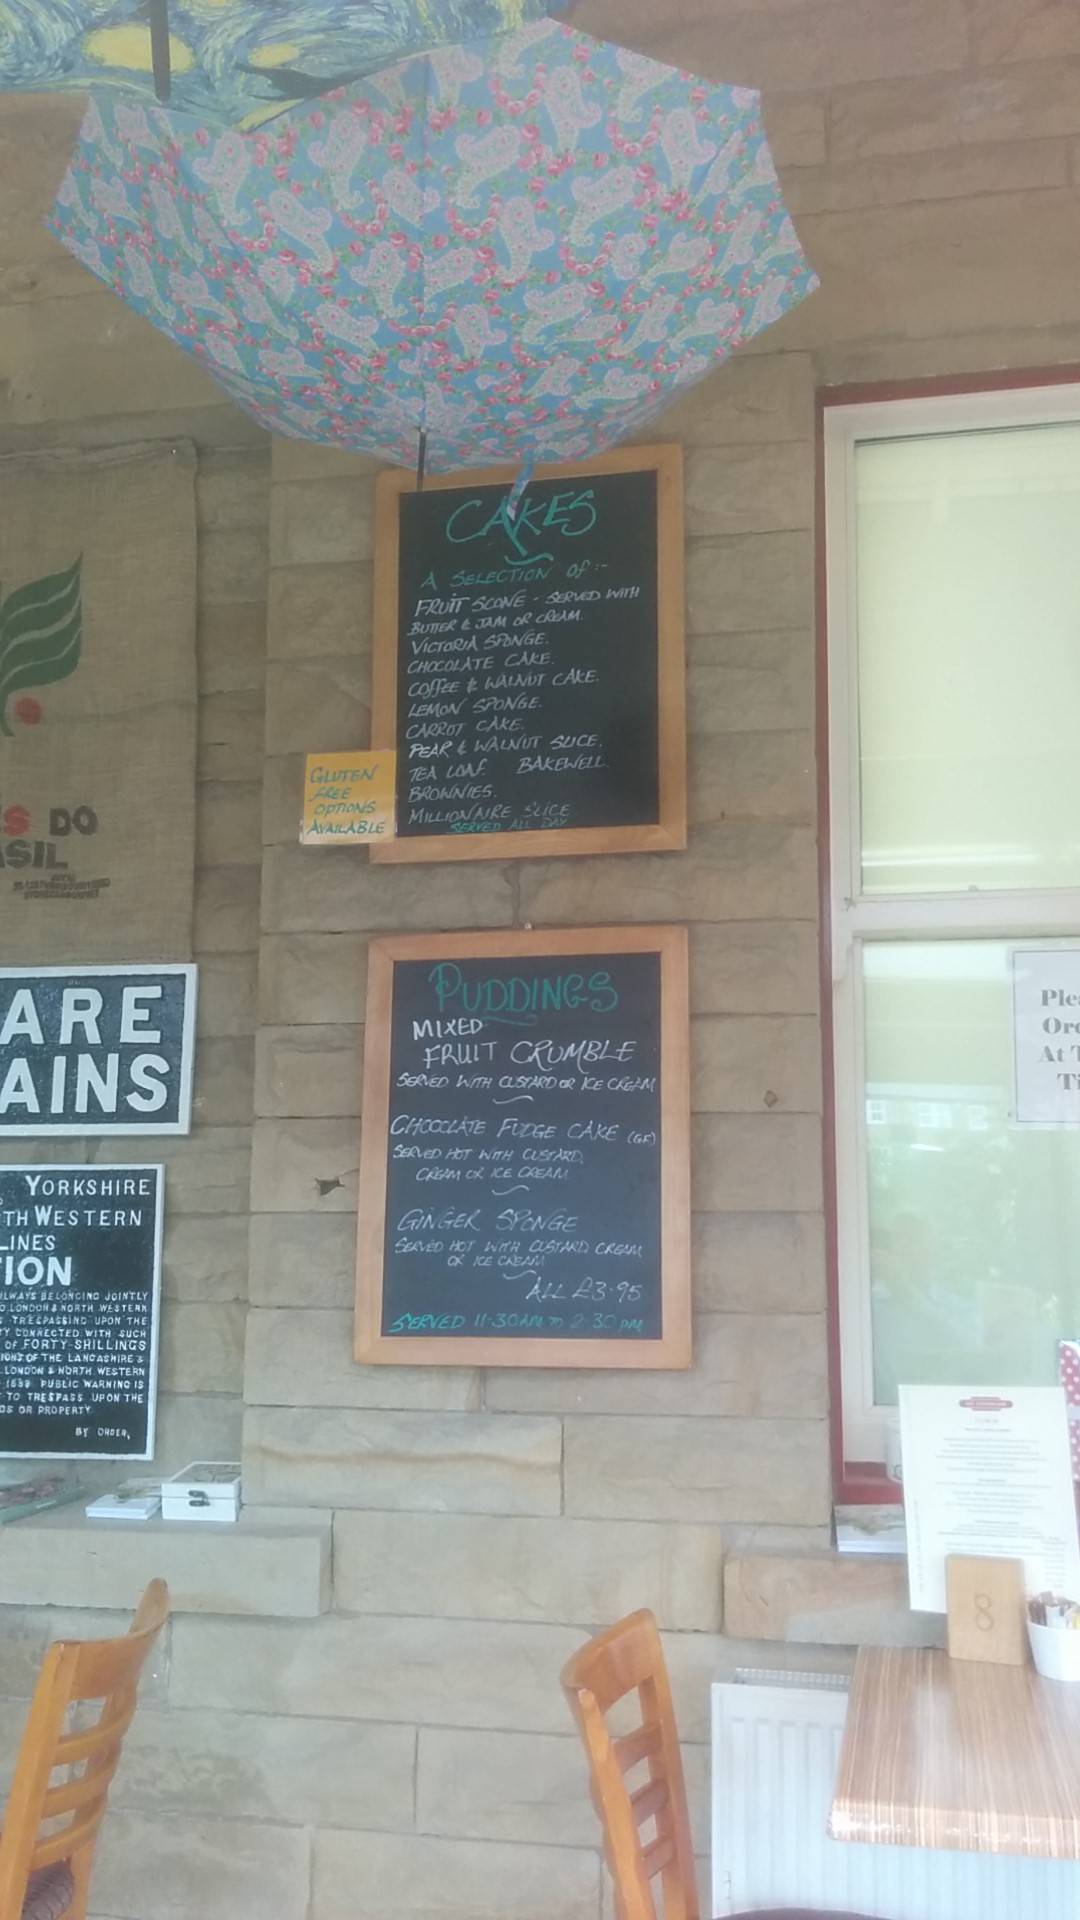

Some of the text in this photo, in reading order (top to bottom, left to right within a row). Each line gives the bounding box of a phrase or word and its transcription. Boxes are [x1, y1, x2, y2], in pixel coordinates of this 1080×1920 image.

[447, 489, 596, 556] CAKES
[420, 571, 438, 591] A
[449, 566, 551, 588] SELECTION
[415, 592, 470, 617] FRUIT
[471, 589, 527, 612] SCONE
[545, 590, 601, 605] SERVED
[606, 586, 641, 600] WITH
[407, 619, 456, 636] BUTTER
[475, 615, 507, 630] JAM
[512, 612, 530, 626] OR
[411, 629, 549, 656] VICTORIA SPONGE.
[407, 651, 555, 675] CHOCOLATE CAKE.
[484, 672, 546, 691] WALNUT
[552, 668, 600, 687] CAKE.
[408, 692, 543, 718] LEMON SPONGE.
[405, 715, 525, 740] CARROT CAKE.
[408, 741, 453, 759] PEAR
[474, 734, 543, 753] WALNUT
[310, 763, 379, 784] GLUTEN
[409, 765, 438, 783] TEA
[309, 786, 352, 802] FREE
[408, 783, 497, 803] BROWNIES.
[314, 800, 376, 817] OPTIONS
[408, 801, 571, 825] MILLIONAIRE SLICE
[49, 805, 98, 836] DO
[307, 818, 385, 835] AVAILABLE
[449, 816, 568, 834] SERVED ALL DAY
[0, 839, 68, 870] SIL
[428, 962, 618, 1013] PUDDINGS
[1040, 989, 1080, 1007] Ple
[0, 985, 162, 1044] ARE
[413, 1017, 484, 1040] MIXED
[423, 1039, 637, 1075] FRUIT CRUMBLE
[1039, 1045, 1065, 1063] At
[0, 1053, 170, 1114] AINS
[396, 1071, 656, 1093] SERVED WITH CUSTARD OR ICE CREAM
[390, 1114, 487, 1138] CHOCOLATE
[496, 1117, 557, 1140] FUDGE
[567, 1119, 619, 1142] CAKE
[392, 1144, 442, 1160] SERVED
[445, 1147, 472, 1161] HOT
[478, 1147, 514, 1162] WITH
[415, 1166, 569, 1182] CREAM OR ICE CREAM
[25, 1175, 151, 1196] YORKSHIRE
[3, 1205, 142, 1227] TH WESTERN
[396, 1207, 580, 1233] GINGER SPONGE
[394, 1236, 643, 1258] SERVED HOT WITH CUSTARD CREAM
[0, 1256, 73, 1286] ION
[447, 1254, 545, 1268] OR ICE CREAM
[104, 1291, 148, 1301] JOINTLY
[525, 1276, 567, 1303] ALL
[10, 1303, 49, 1312] LONDON
[61, 1304, 94, 1313] NORTH
[99, 1304, 147, 1313] WESTERN
[12, 1315, 87, 1325] TRESPASSING
[95, 1316, 121, 1326] UPON
[127, 1316, 148, 1326] THE
[389, 1312, 466, 1333] SERVED
[16, 1328, 79, 1337] CONNECTED
[85, 1329, 111, 1338] WITH
[119, 1329, 146, 1338] SUCH
[5, 1339, 147, 1351] OF FORTY SHILLINGS
[41, 1353, 62, 1362] THE
[68, 1352, 134, 1363] LANCASHIRE
[4, 1366, 44, 1375] LONDON
[58, 1366, 92, 1375] NORTH
[97, 1366, 145, 1376] WESTERN
[40, 1380, 79, 1389] PUBLIC
[83, 1380, 131, 1390] WARNING
[134, 1380, 145, 1389] IS
[6, 1391, 20, 1401] TO
[27, 1392, 83, 1402] TRESPASS
[92, 1393, 120, 1402] UPON
[123, 1393, 144, 1404] THE
[18, 1405, 33, 1415] OR
[38, 1405, 91, 1415] PROPERTY
[75, 1427, 88, 1438] BY
[974, 1592, 995, 1632] 8
